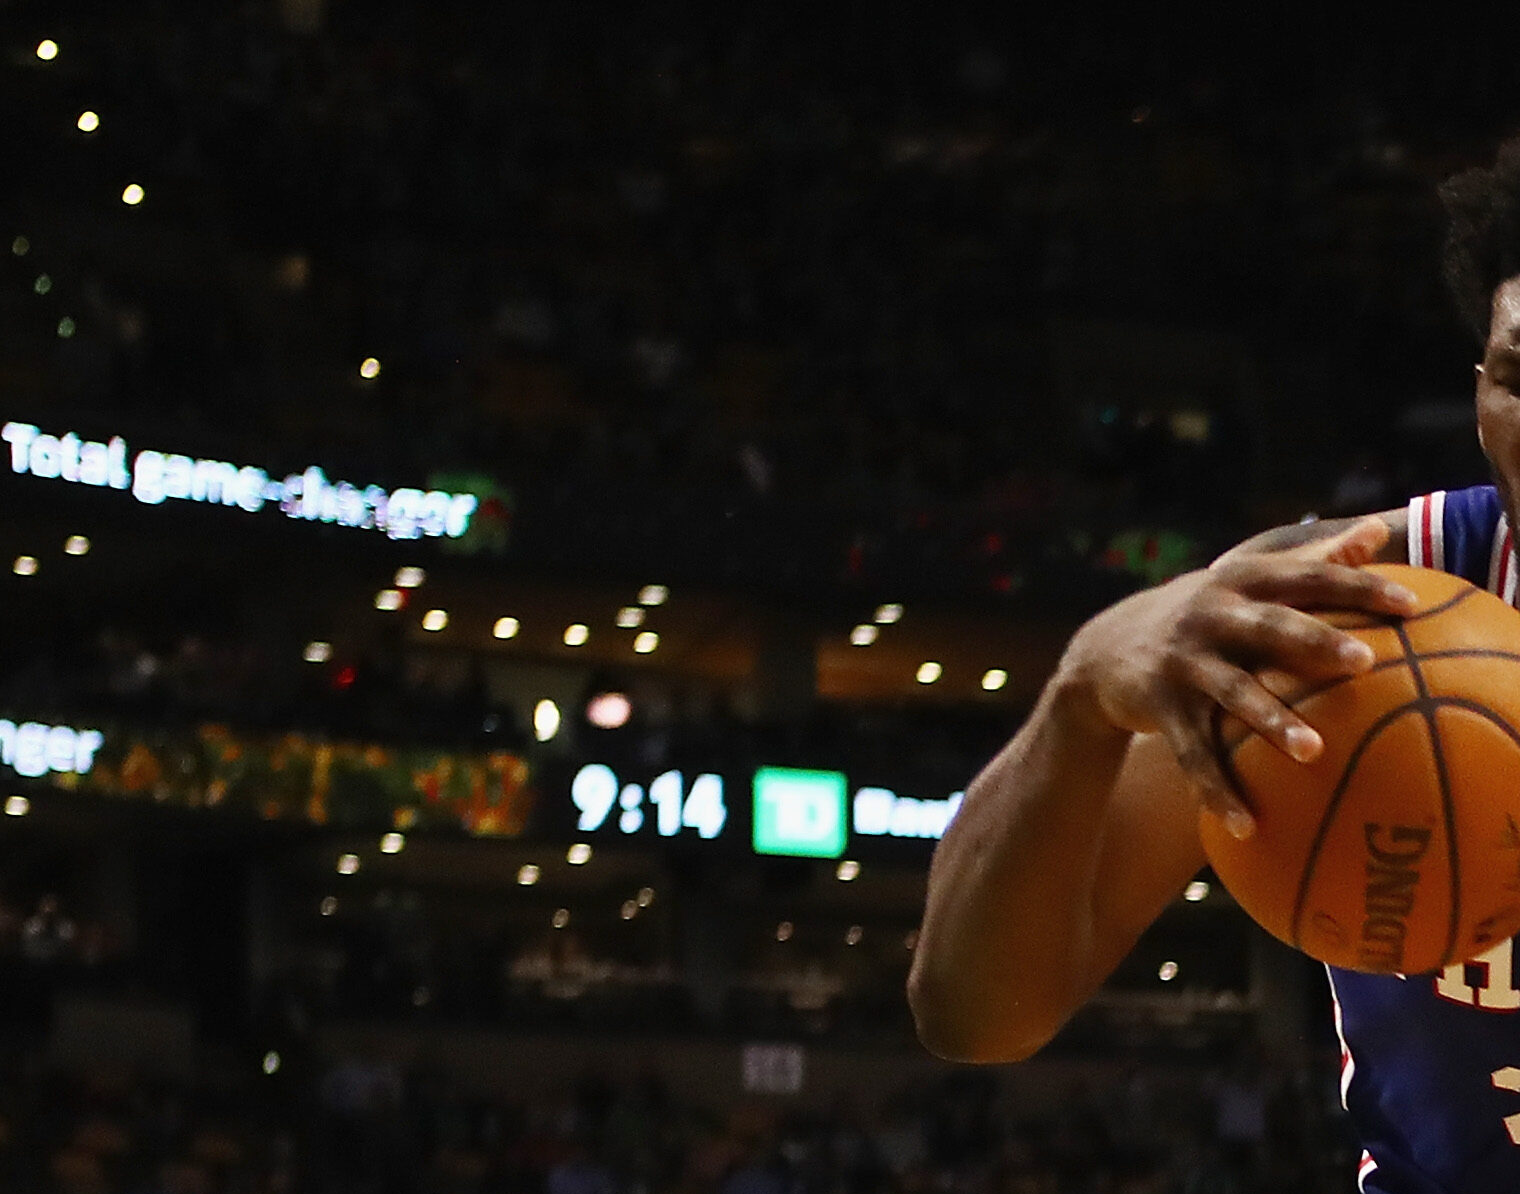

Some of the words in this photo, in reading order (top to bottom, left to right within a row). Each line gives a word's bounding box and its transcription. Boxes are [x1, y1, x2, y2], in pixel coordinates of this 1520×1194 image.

[1, 421, 131, 490] Total
[132, 449, 479, 540] game-changer
[571, 763, 726, 840] 9:14
